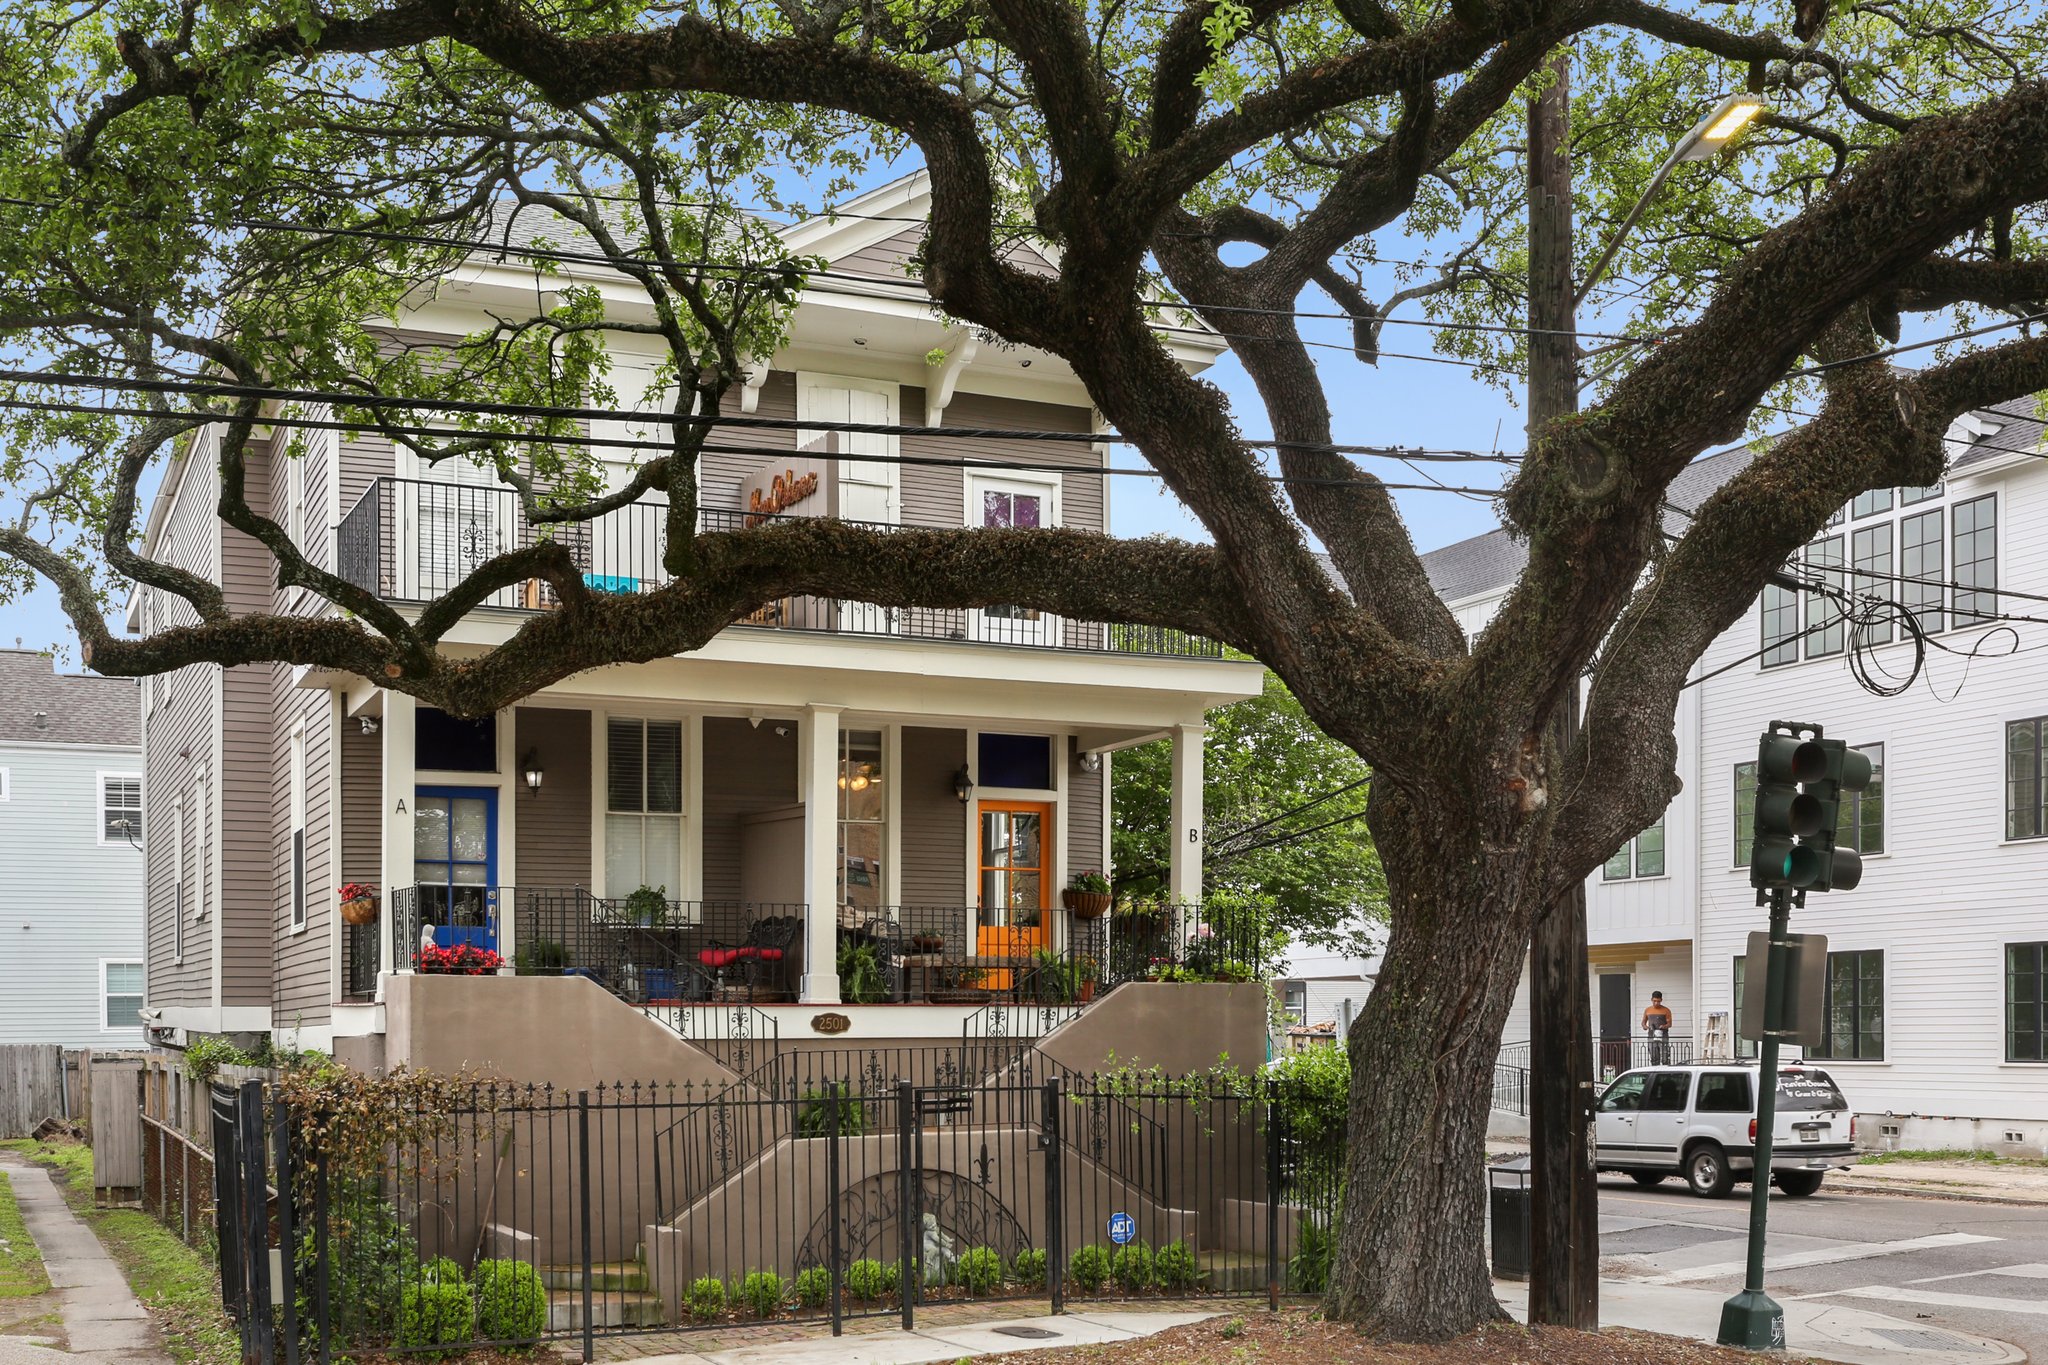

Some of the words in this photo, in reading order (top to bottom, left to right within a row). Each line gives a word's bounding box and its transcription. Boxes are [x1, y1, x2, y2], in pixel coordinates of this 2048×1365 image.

[395, 798, 407, 814] A
[1189, 828, 1198, 843] B
[819, 1016, 843, 1030] 2501
[1111, 1220, 1132, 1233] ADT
